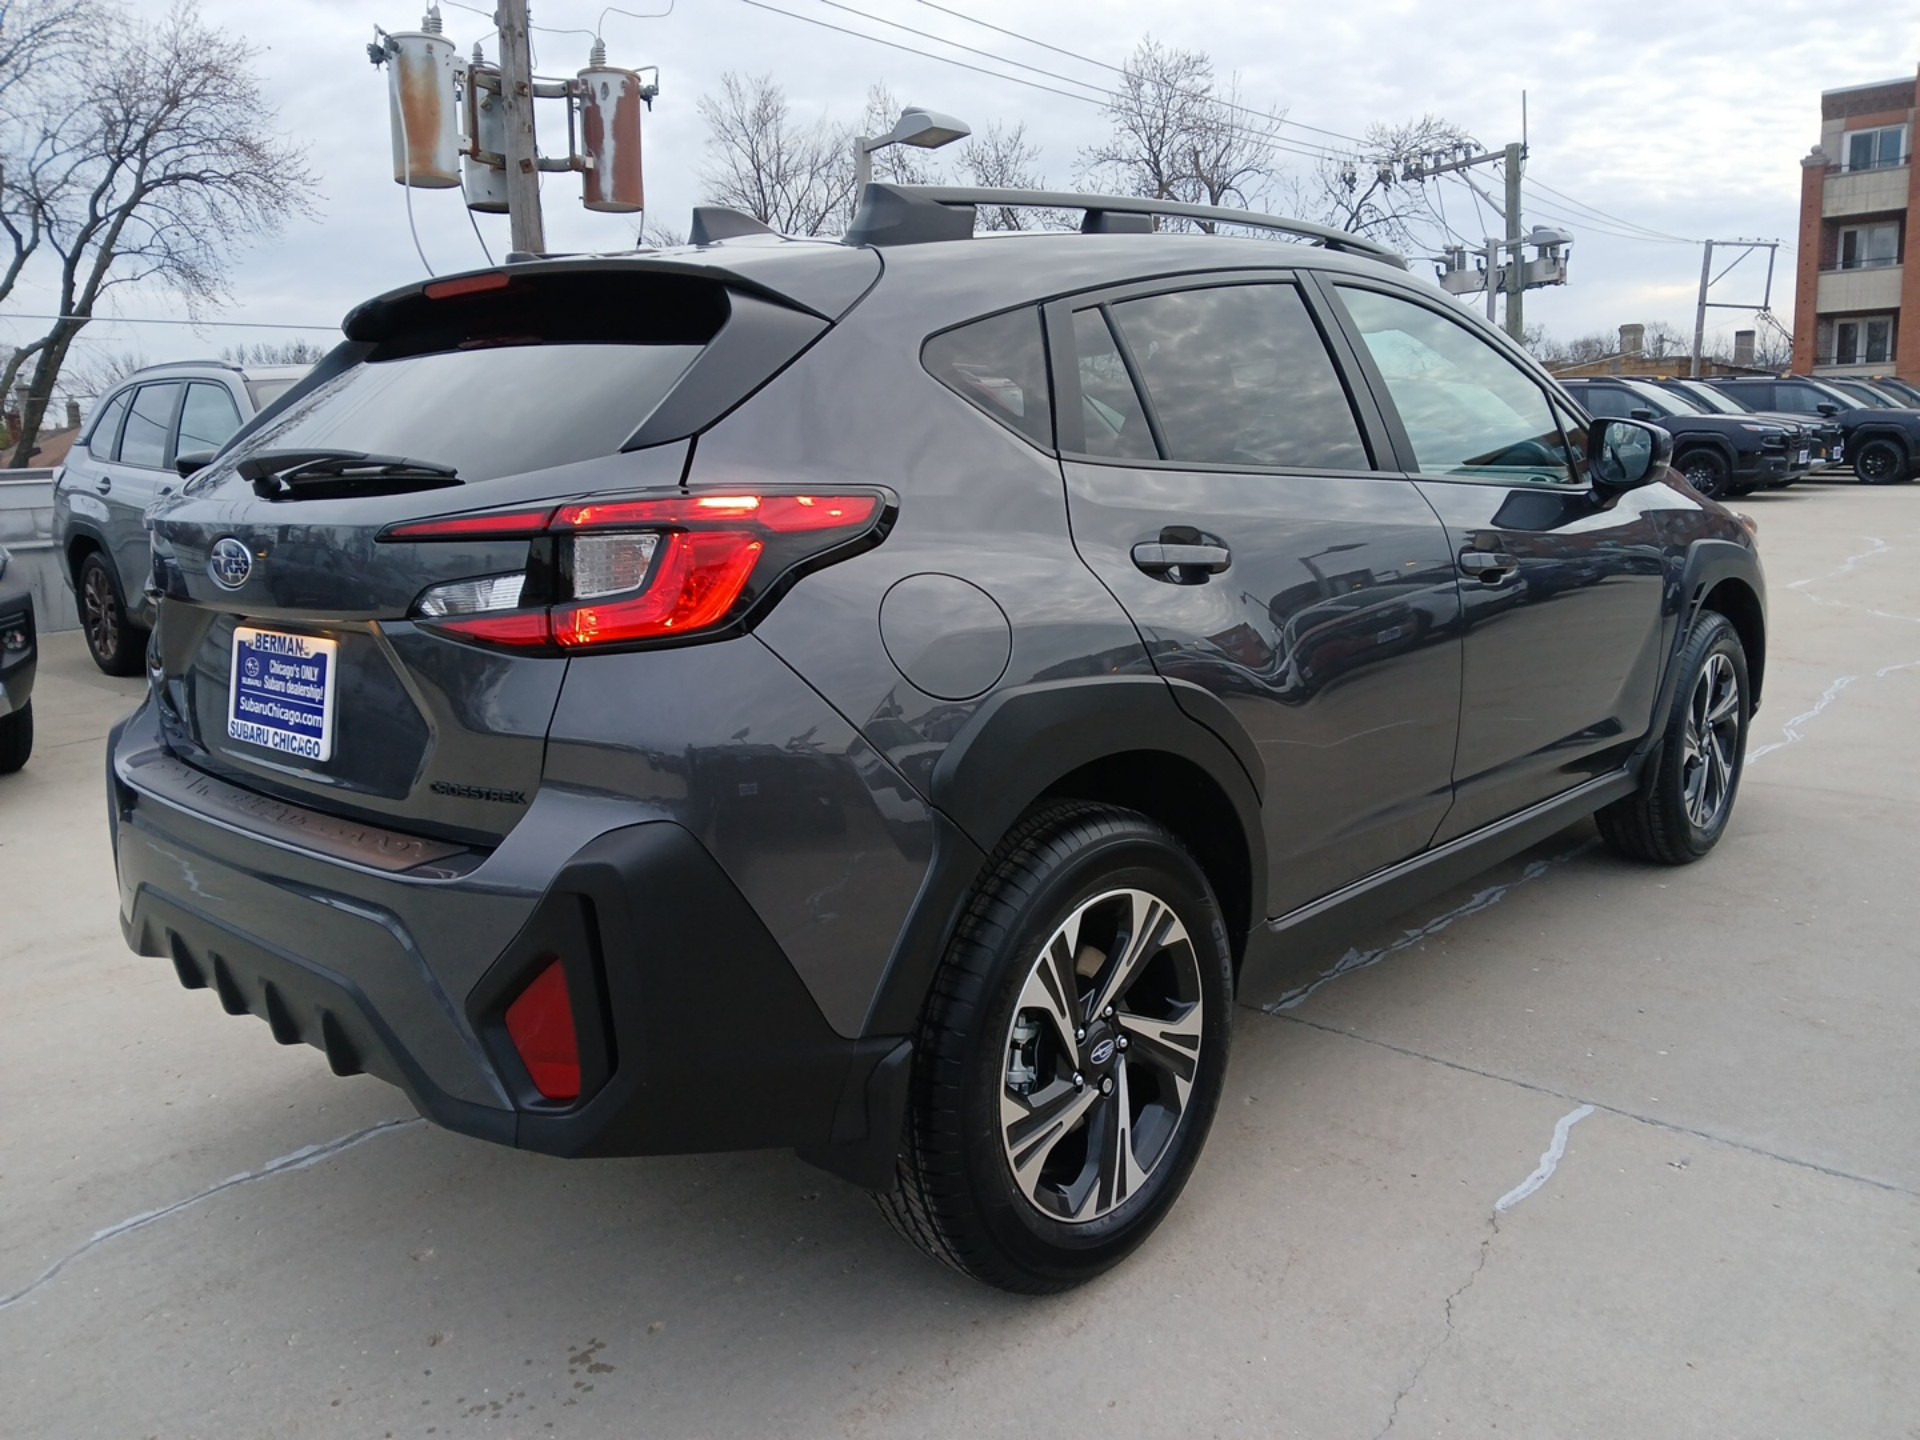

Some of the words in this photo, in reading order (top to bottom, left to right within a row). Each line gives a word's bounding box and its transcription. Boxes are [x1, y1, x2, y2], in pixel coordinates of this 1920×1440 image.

[255, 632, 304, 657] BERMAN
[269, 659, 300, 680] Chicago's
[301, 665, 320, 681] ONLY
[263, 675, 286, 693] Subaru
[286, 680, 324, 702] dealership!
[240, 696, 323, 728] SubaruChicago.com
[230, 720, 269, 745] SUBARU
[271, 731, 321, 758] CHICAGO
